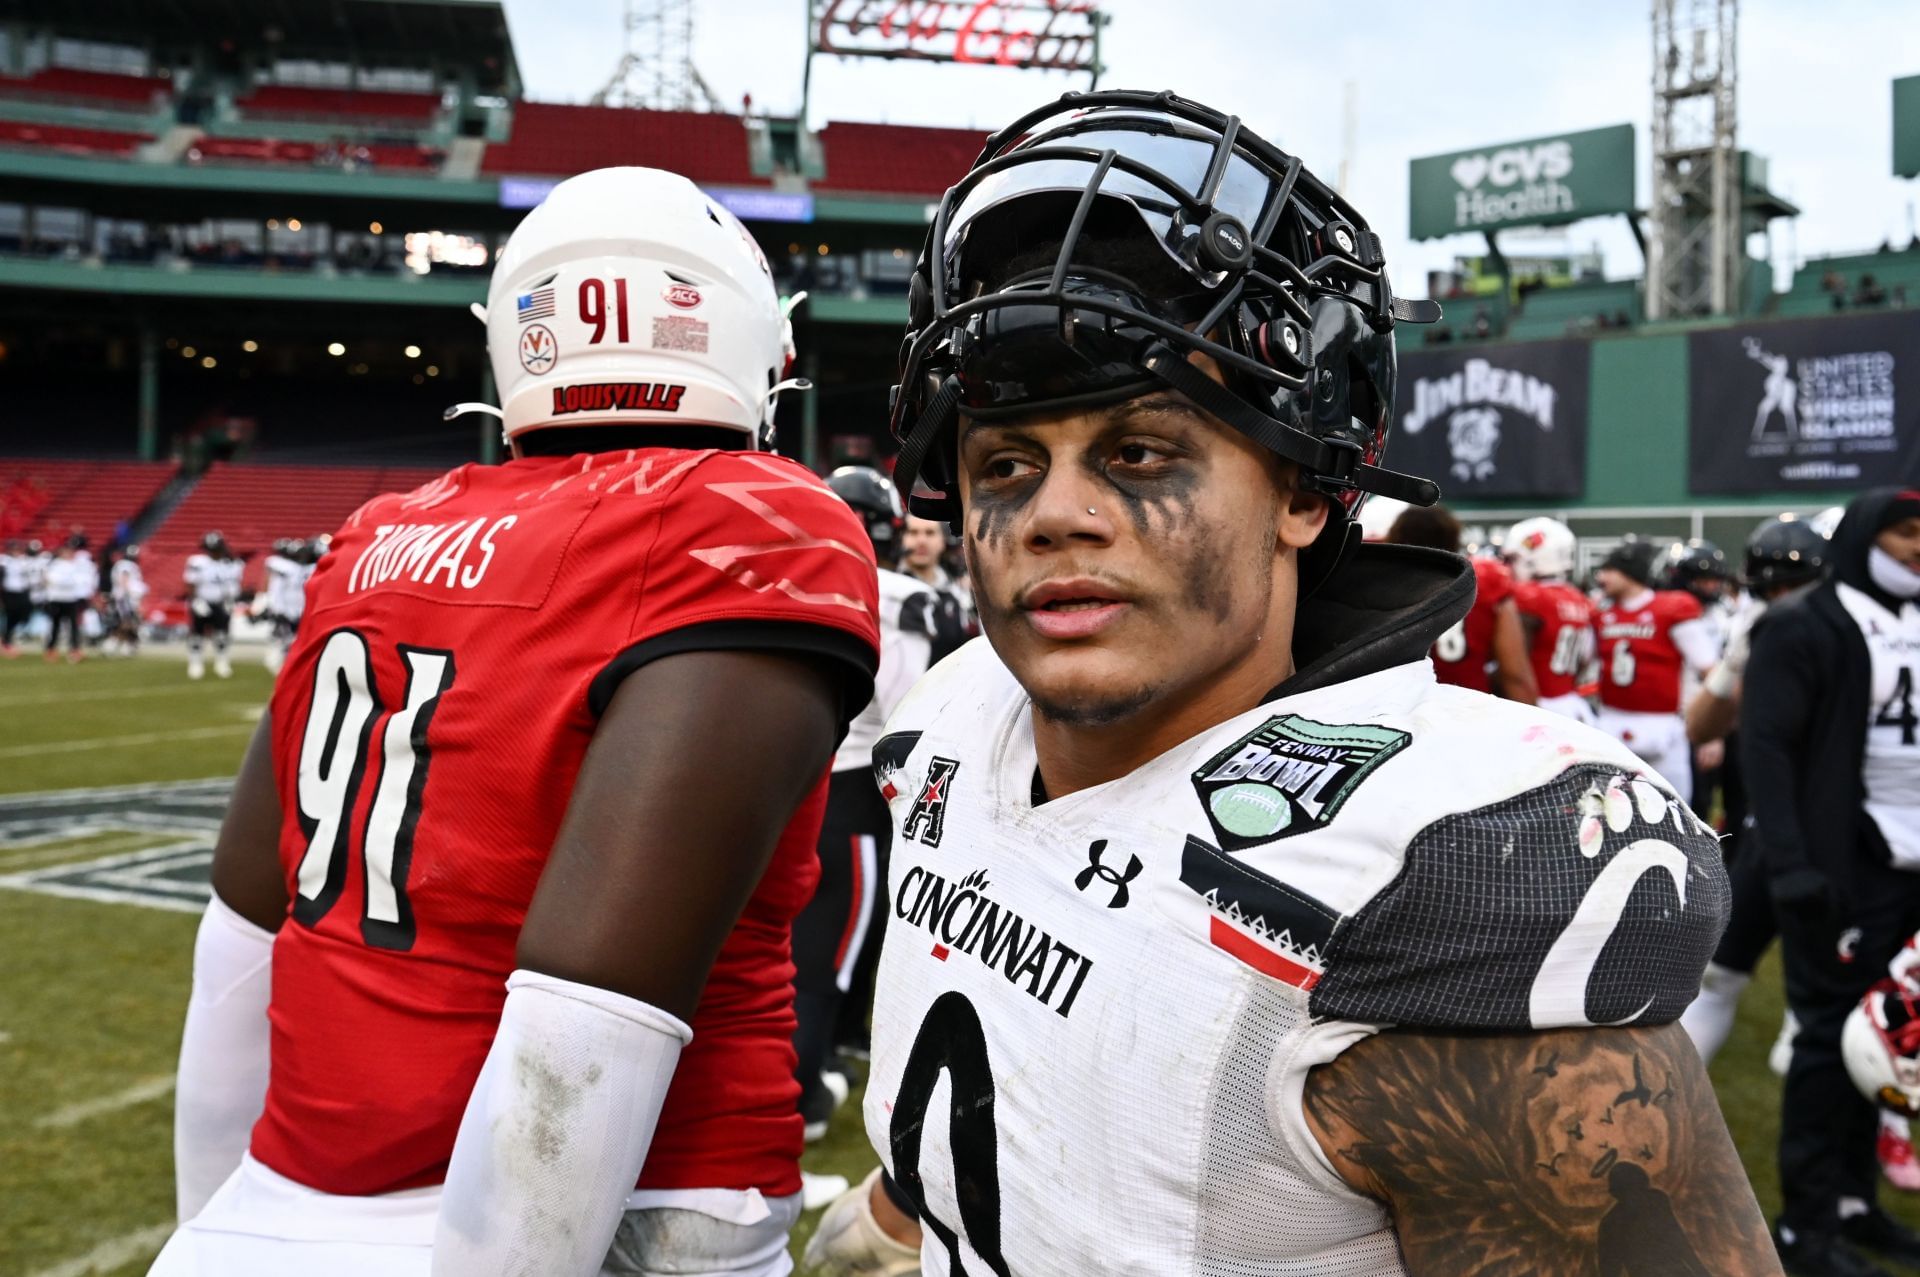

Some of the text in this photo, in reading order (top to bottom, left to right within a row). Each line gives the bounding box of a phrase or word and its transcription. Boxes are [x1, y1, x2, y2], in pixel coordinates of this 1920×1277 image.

[1488, 141, 1573, 187] CVS
[1455, 181, 1574, 227] Health
[578, 277, 630, 345] 91
[670, 288, 699, 304] ACC
[551, 382, 687, 415] LOUISVILLE
[1465, 358, 1556, 433] BEAM
[347, 514, 518, 594] THOMAS
[1611, 639, 1635, 687] 6
[1271, 739, 1350, 761] FENWAY
[292, 627, 456, 950] 91
[1202, 743, 1346, 820] BOWL
[895, 866, 1094, 1018] CINCINNATI
